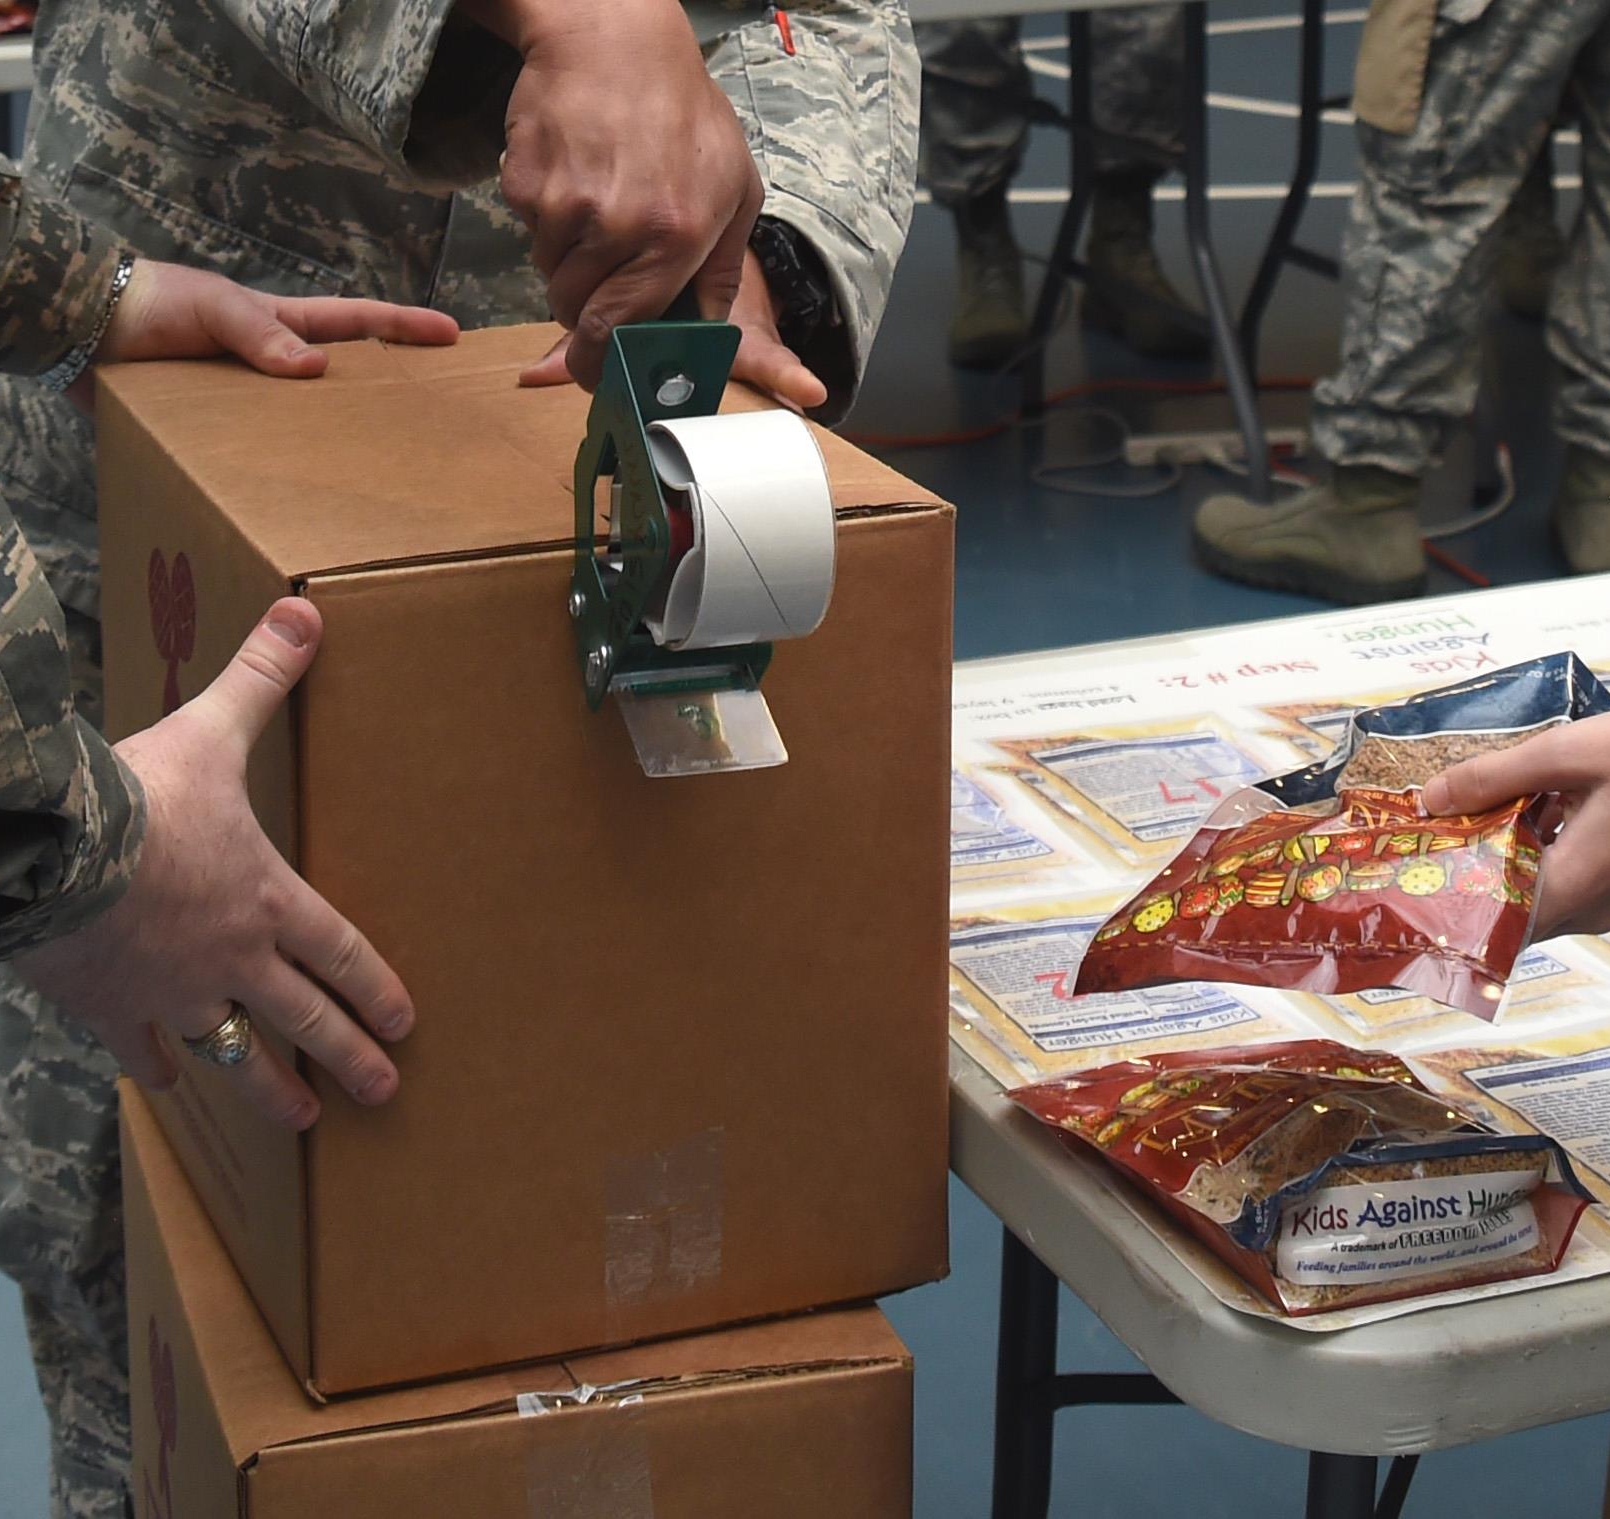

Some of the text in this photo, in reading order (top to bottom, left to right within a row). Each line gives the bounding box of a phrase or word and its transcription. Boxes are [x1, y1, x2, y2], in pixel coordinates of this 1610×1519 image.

[1350, 632, 1489, 660] Against
[1235, 660, 1319, 677] Step
[1410, 651, 1500, 674] Kids
[1126, 1019, 1202, 1037] Against
[1291, 1204, 1348, 1237] Kids
[1355, 1195, 1463, 1228] Against
[1330, 1242, 1339, 1253] A
[1340, 1240, 1387, 1253] trademark
[1388, 1239, 1398, 1250] of
[1398, 1223, 1479, 1249] FREEDOM
[1296, 1260, 1336, 1274] Feeding
[1337, 1259, 1377, 1274] families
[1378, 1258, 1413, 1270] around
[1413, 1253, 1428, 1265] the
